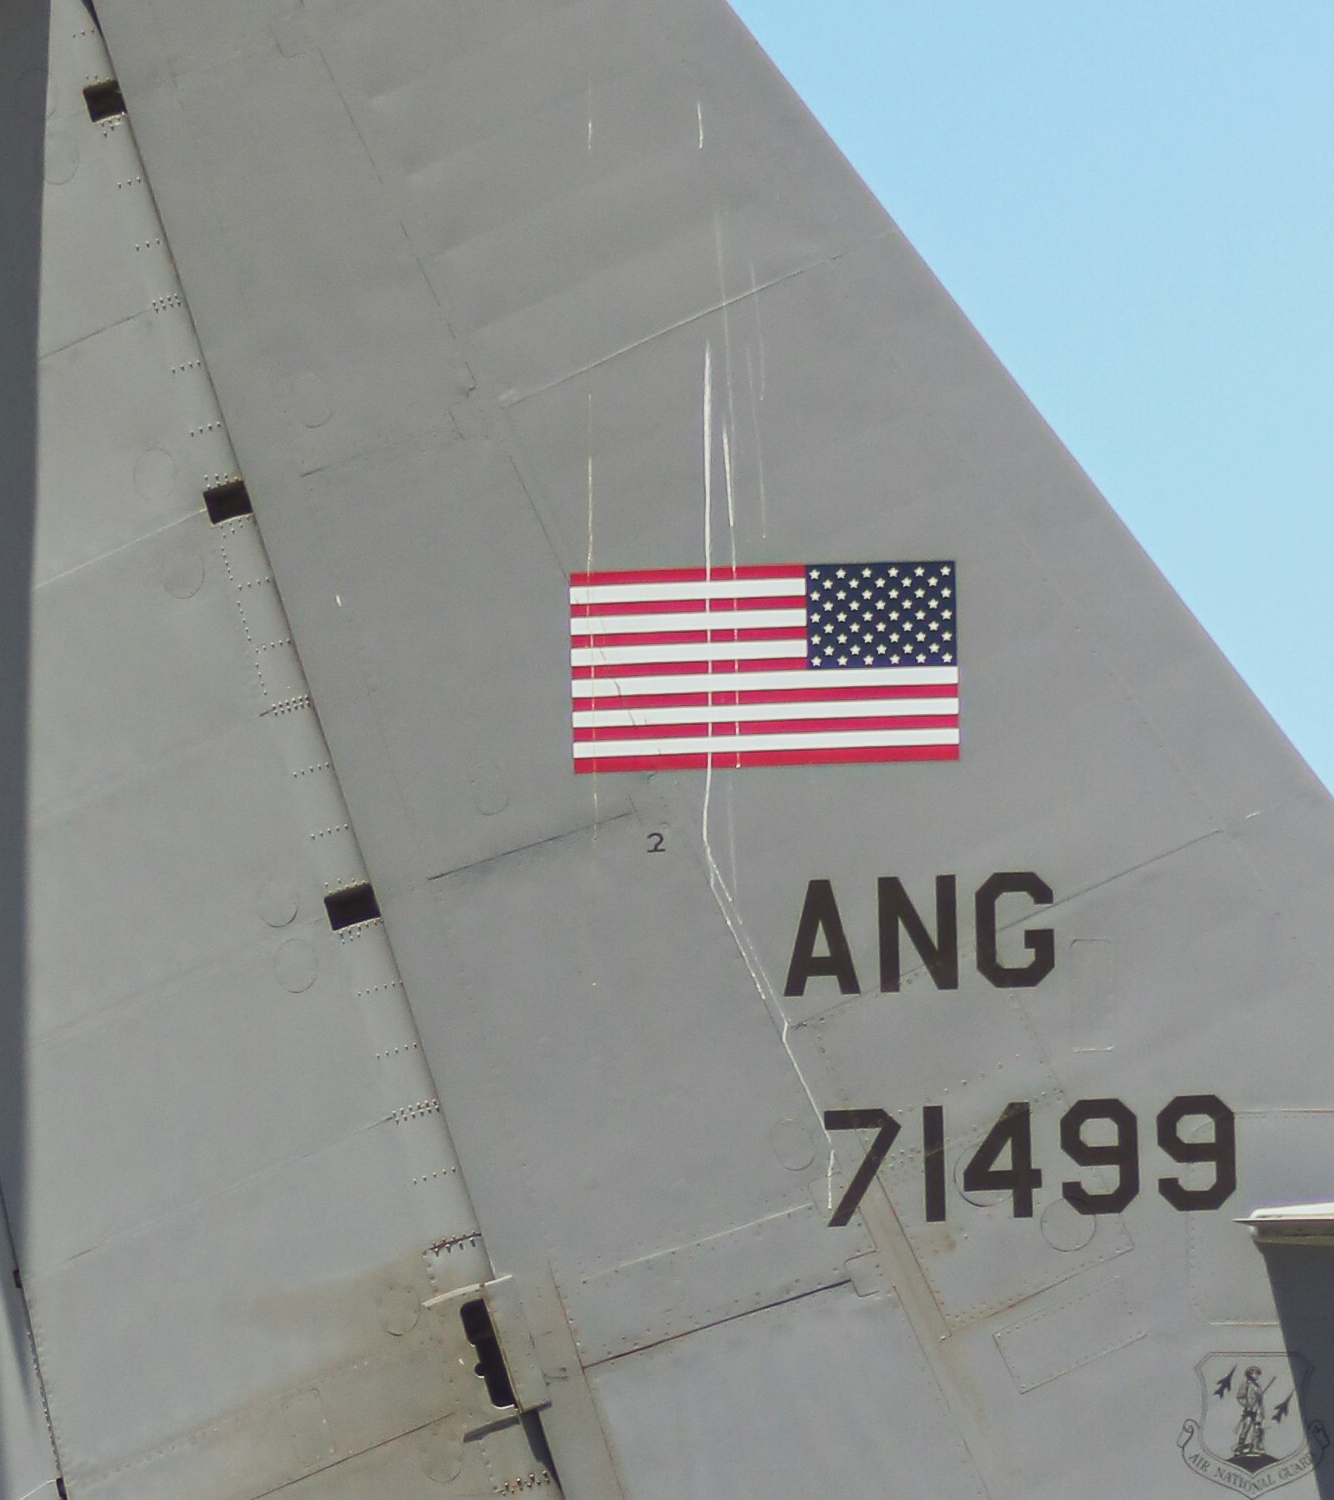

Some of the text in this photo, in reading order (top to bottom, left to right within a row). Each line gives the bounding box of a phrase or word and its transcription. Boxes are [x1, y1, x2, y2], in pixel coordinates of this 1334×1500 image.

[647, 832, 666, 853] 2
[783, 871, 1056, 997] ANG
[822, 1093, 1236, 1227] 71499
[1188, 1452, 1315, 1494] AIR NATIONAL GUARD
